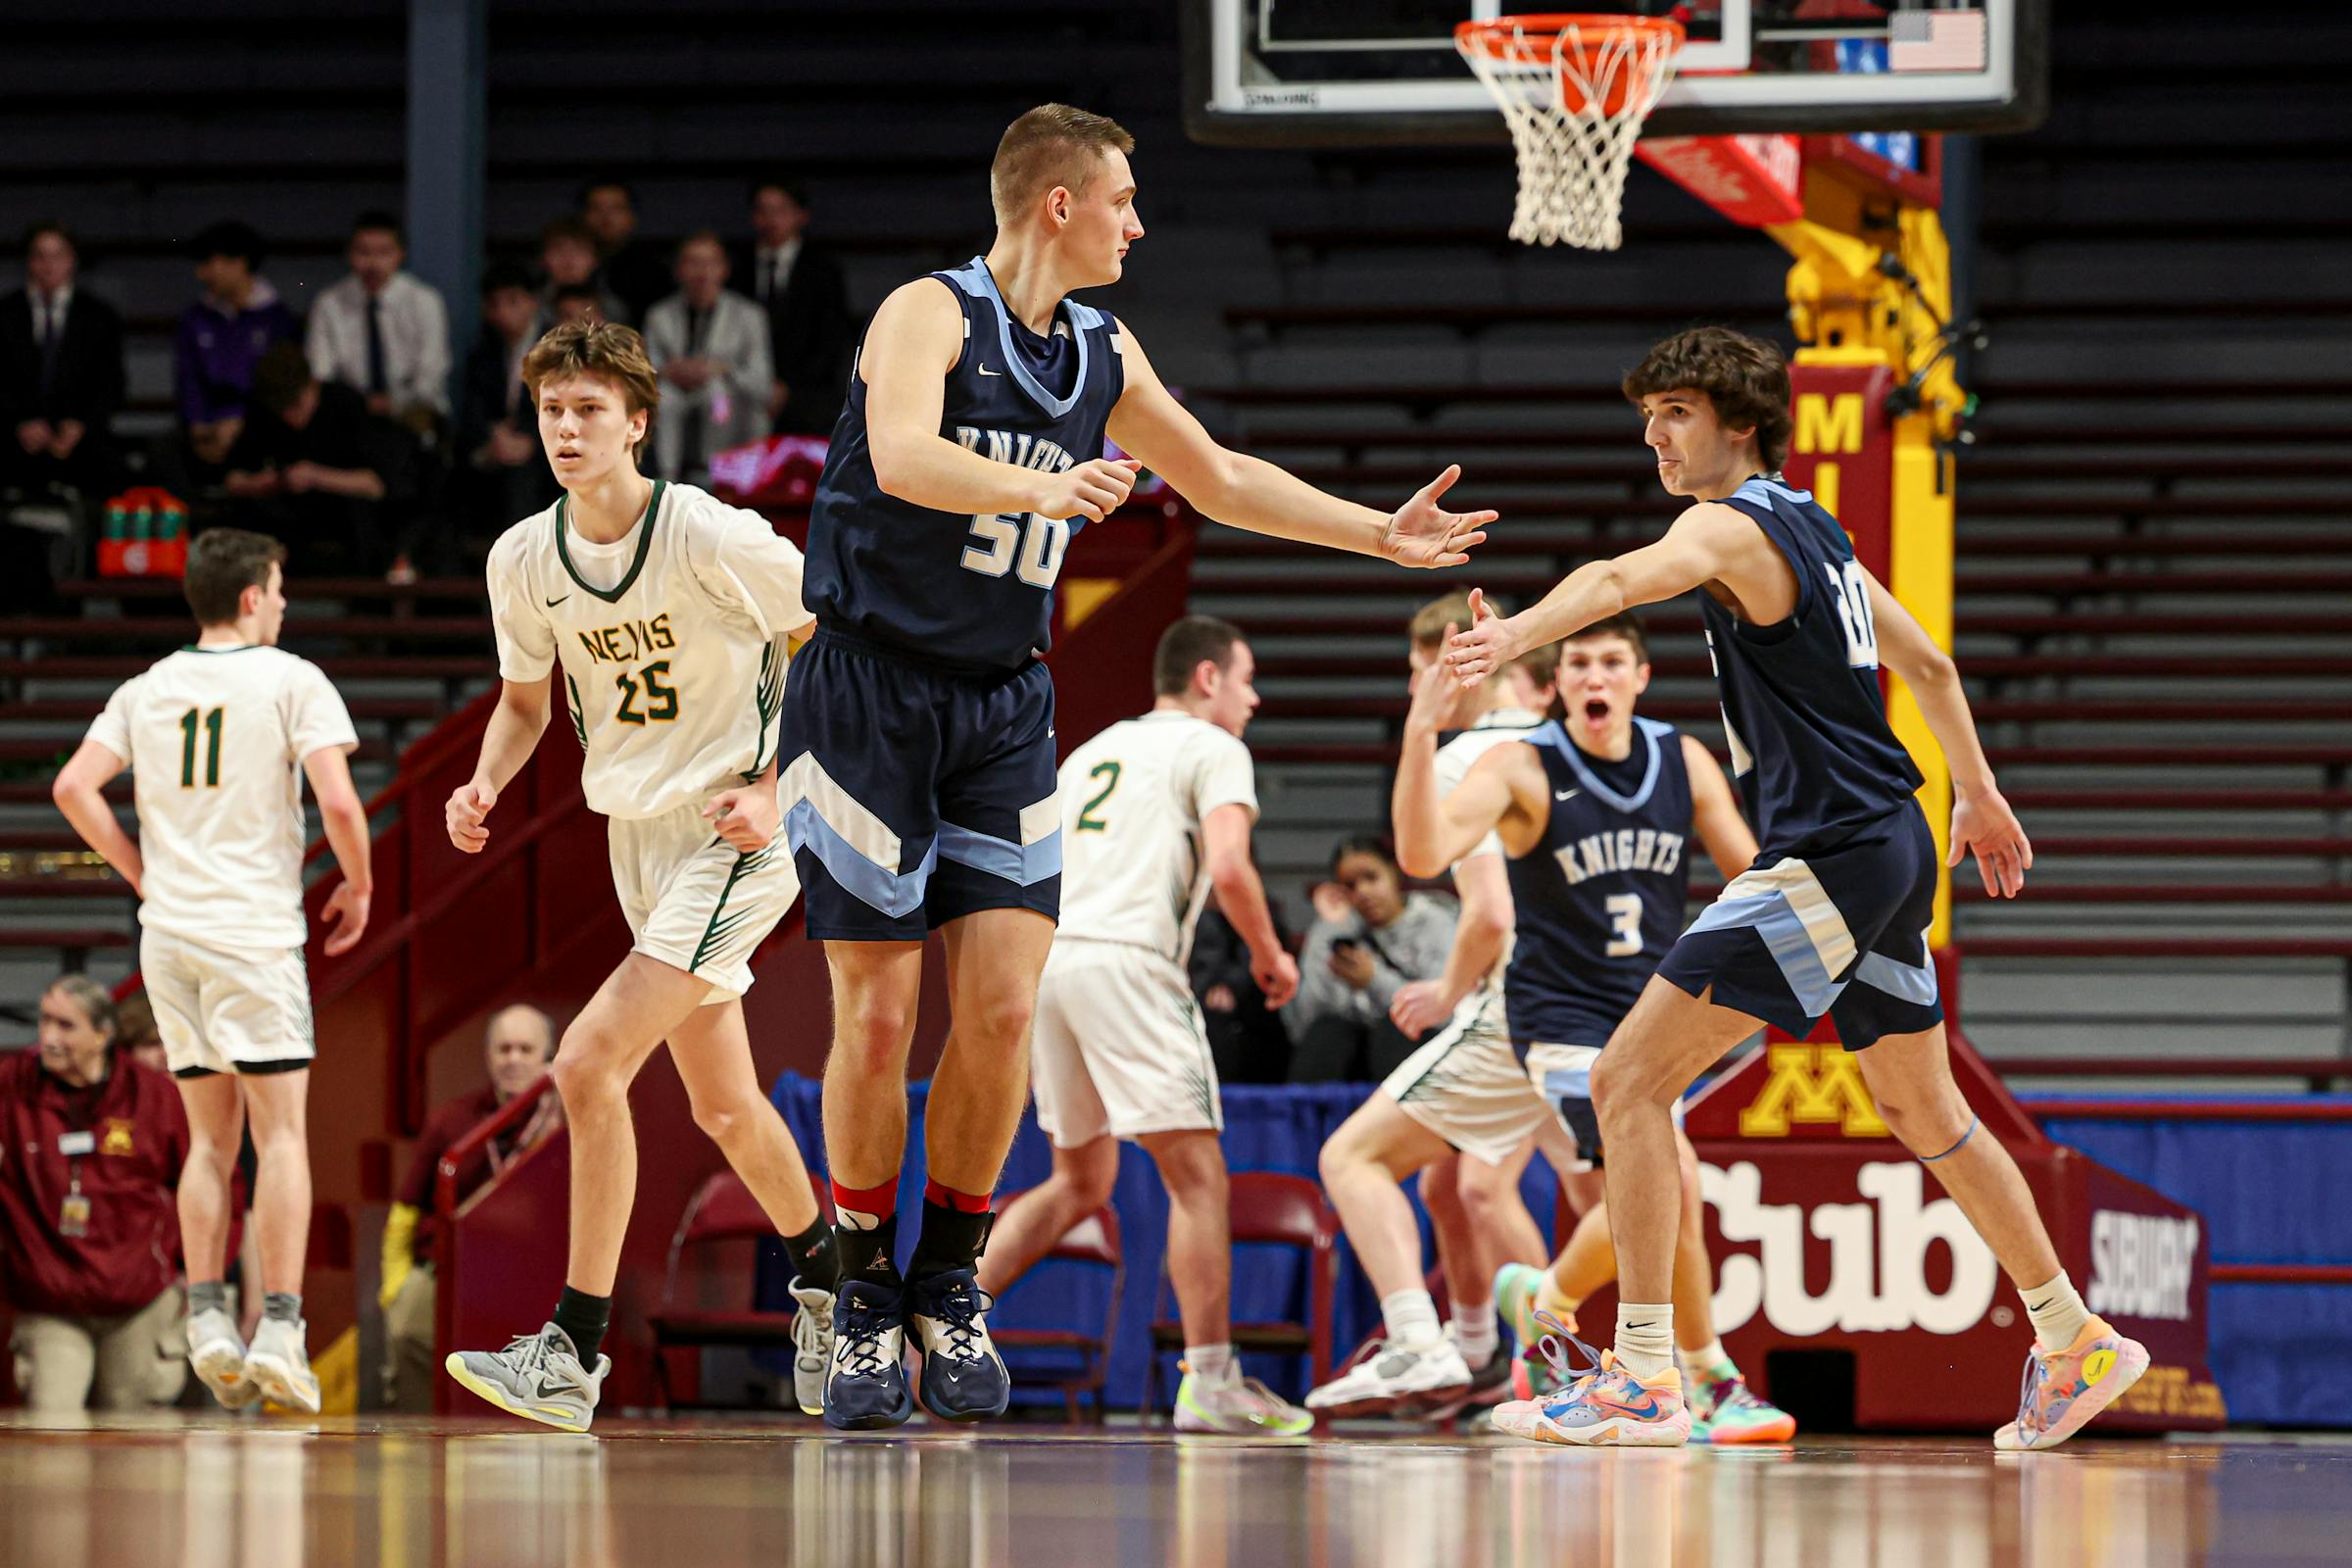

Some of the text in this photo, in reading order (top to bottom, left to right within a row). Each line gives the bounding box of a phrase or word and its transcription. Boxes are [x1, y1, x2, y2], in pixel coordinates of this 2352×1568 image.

[960, 512, 1070, 591] 50
[577, 612, 676, 664] NEVIS
[614, 659, 679, 727] 25
[179, 705, 224, 789] 11
[1075, 760, 1122, 833] 2
[1553, 828, 1684, 886] KNIGHTS
[1605, 893, 1644, 957] 3
[1739, 1043, 1897, 1138] M
[1698, 1160, 1998, 1338] Cub
